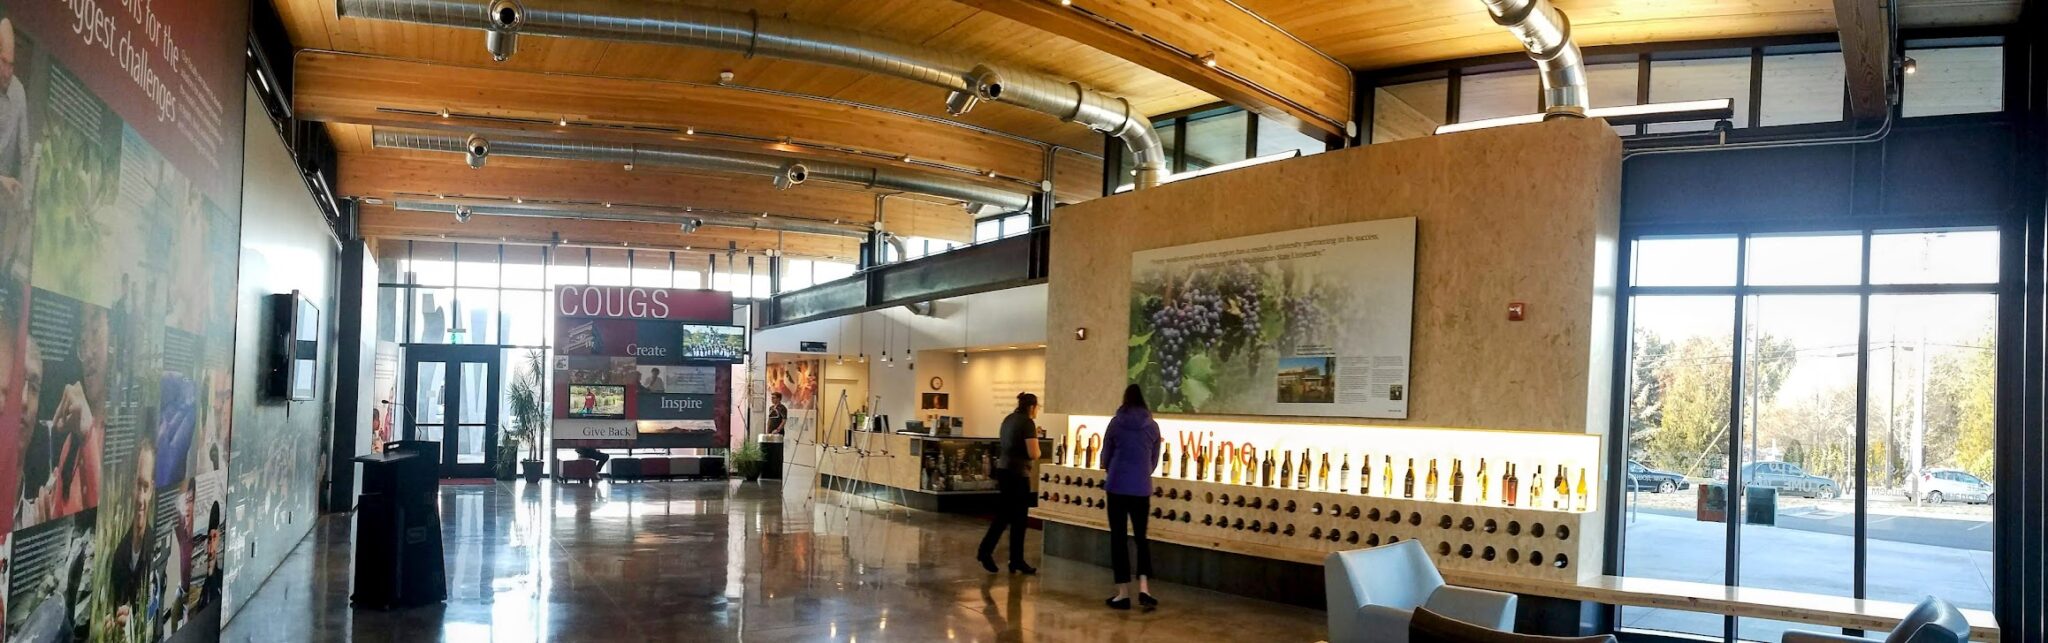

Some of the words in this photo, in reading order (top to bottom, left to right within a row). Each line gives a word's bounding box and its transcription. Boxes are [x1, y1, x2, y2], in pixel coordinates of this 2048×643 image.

[145, 0, 161, 47] for
[163, 25, 179, 72] the
[62, 0, 116, 57] ggest
[119, 30, 176, 122] challenges
[559, 286, 669, 319] COUGS
[626, 343, 667, 357] Create
[661, 397, 703, 412] Inspire
[582, 426, 606, 437] Give
[608, 426, 631, 437] Back
[1179, 431, 1254, 467] Wine
